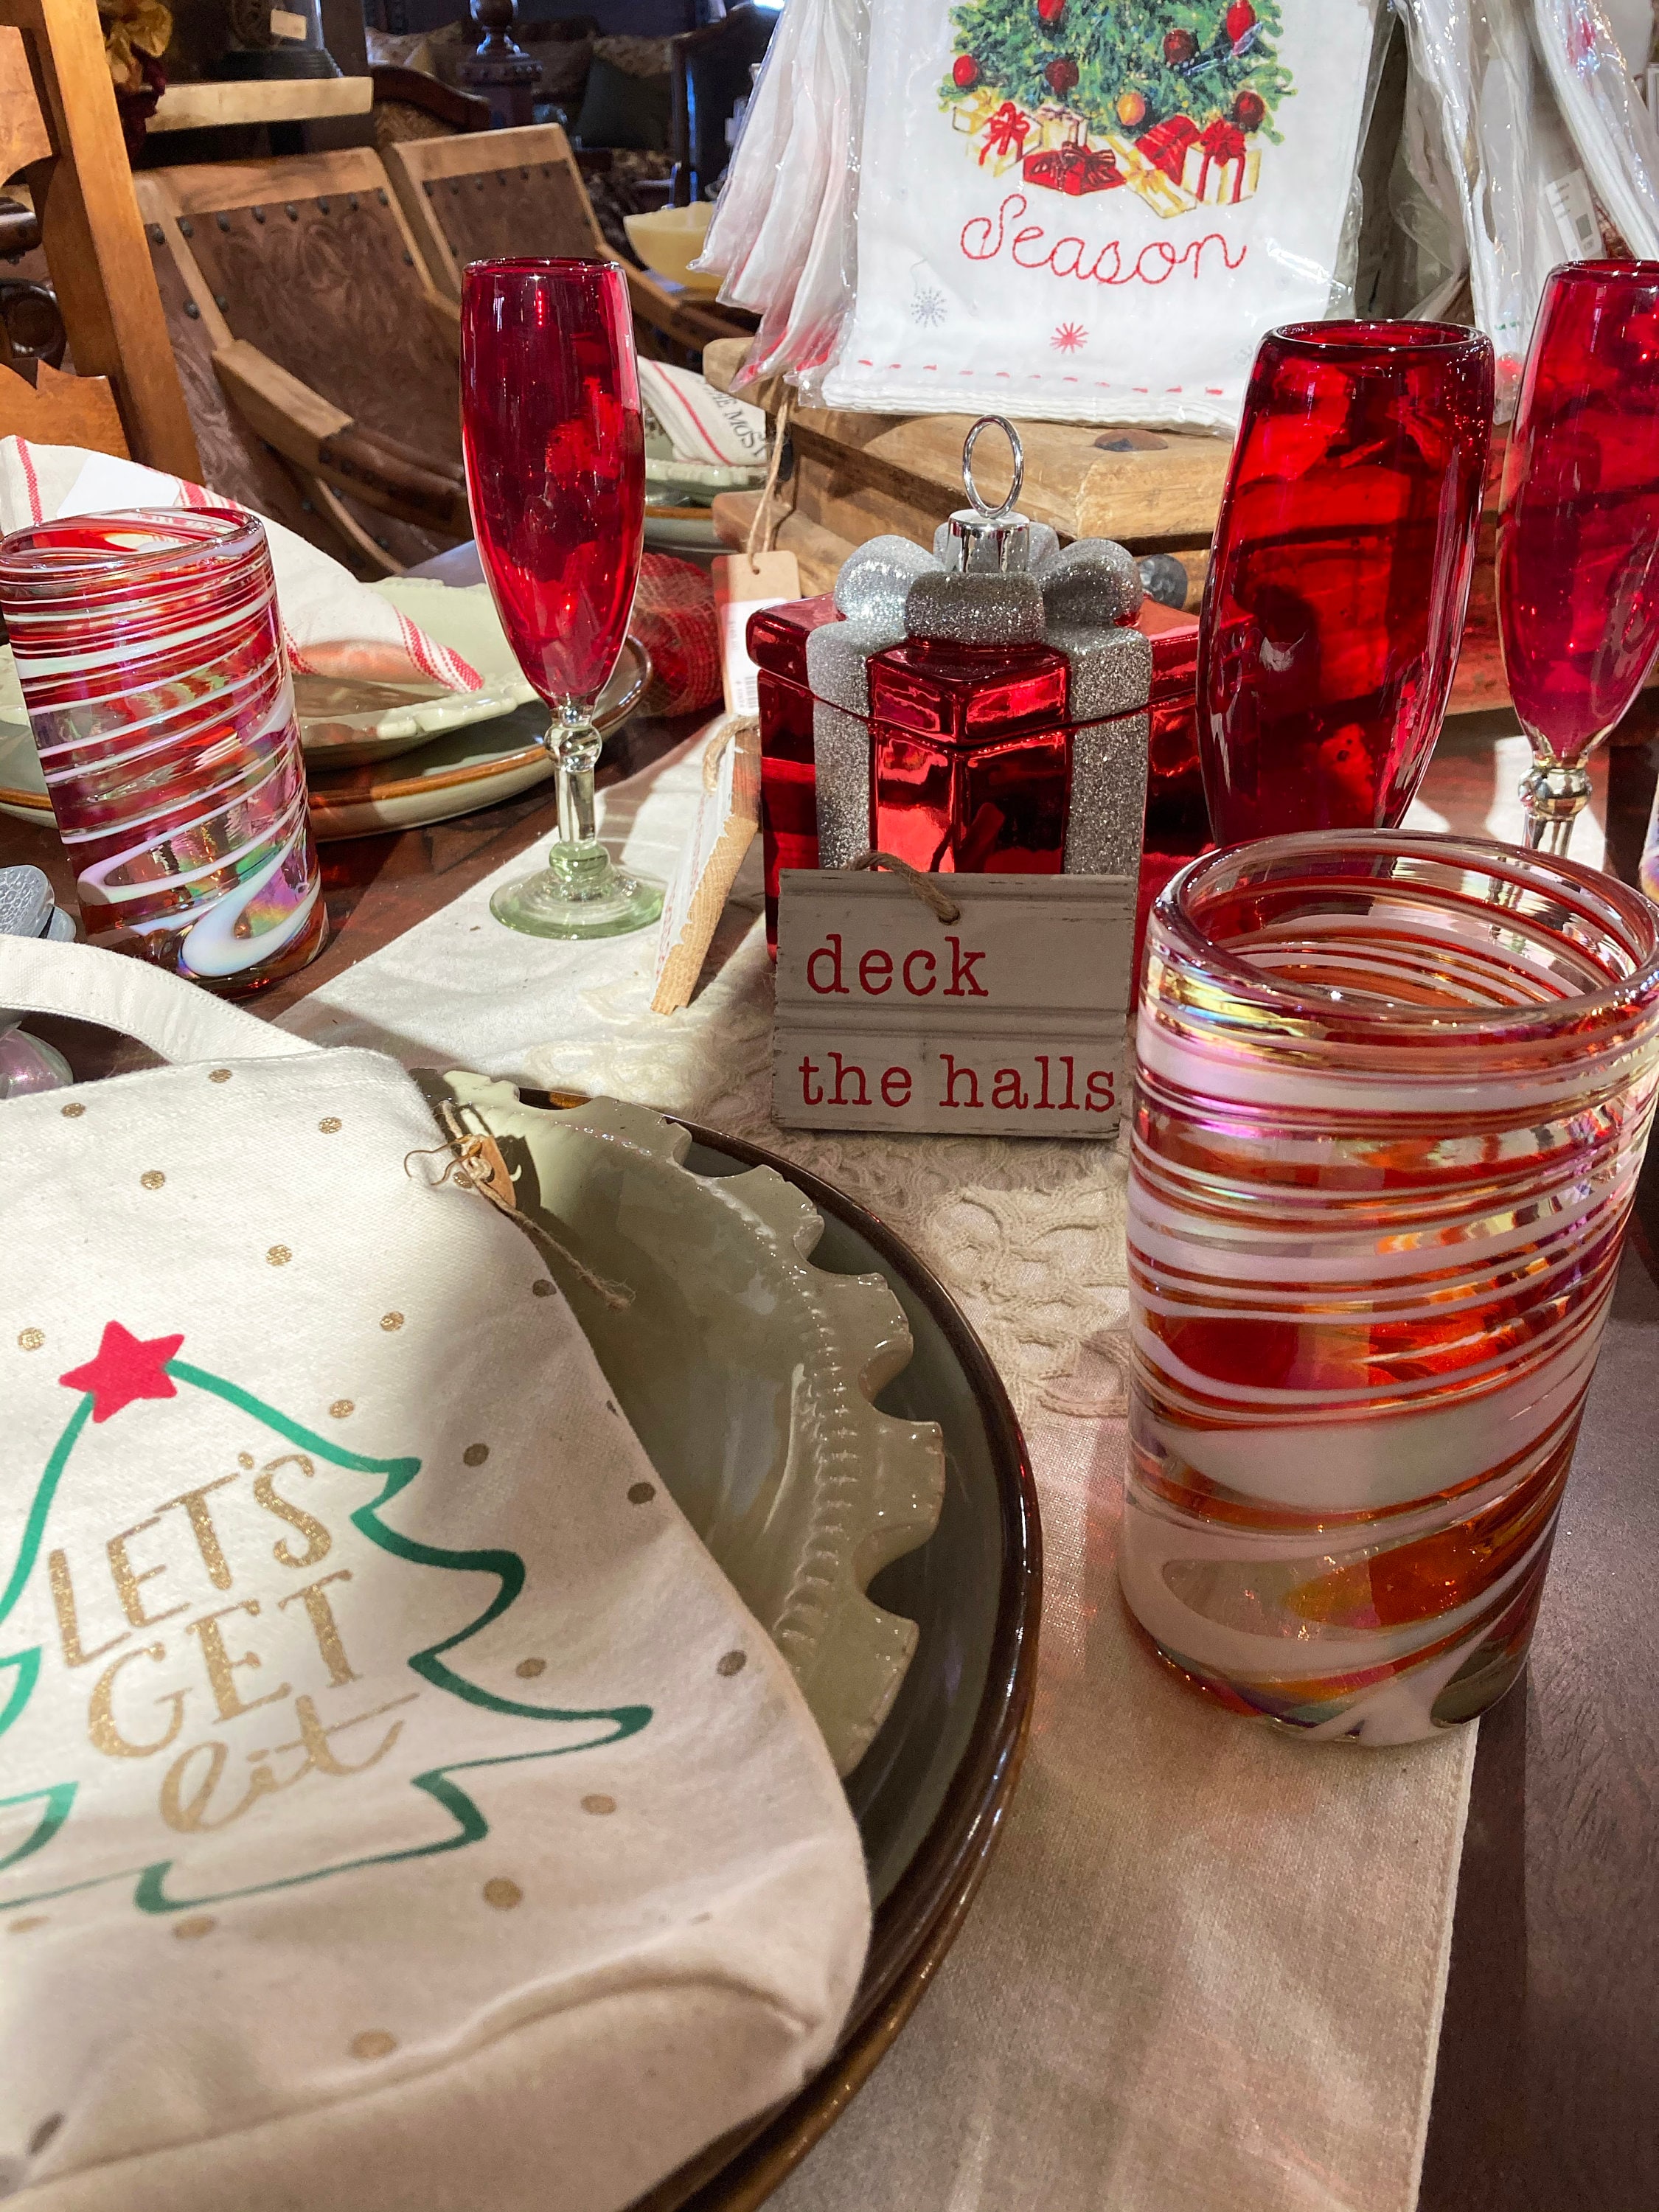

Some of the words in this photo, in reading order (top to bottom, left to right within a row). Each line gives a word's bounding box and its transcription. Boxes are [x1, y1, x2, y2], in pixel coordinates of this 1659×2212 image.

[960, 193, 1248, 285] Season
[807, 933, 990, 997] deck
[798, 1051, 913, 1107] the
[939, 1054, 1116, 1113] halls
[48, 1450, 333, 1669] LET'S
[88, 1568, 364, 1758] GET
[159, 1693, 420, 1834] lit
